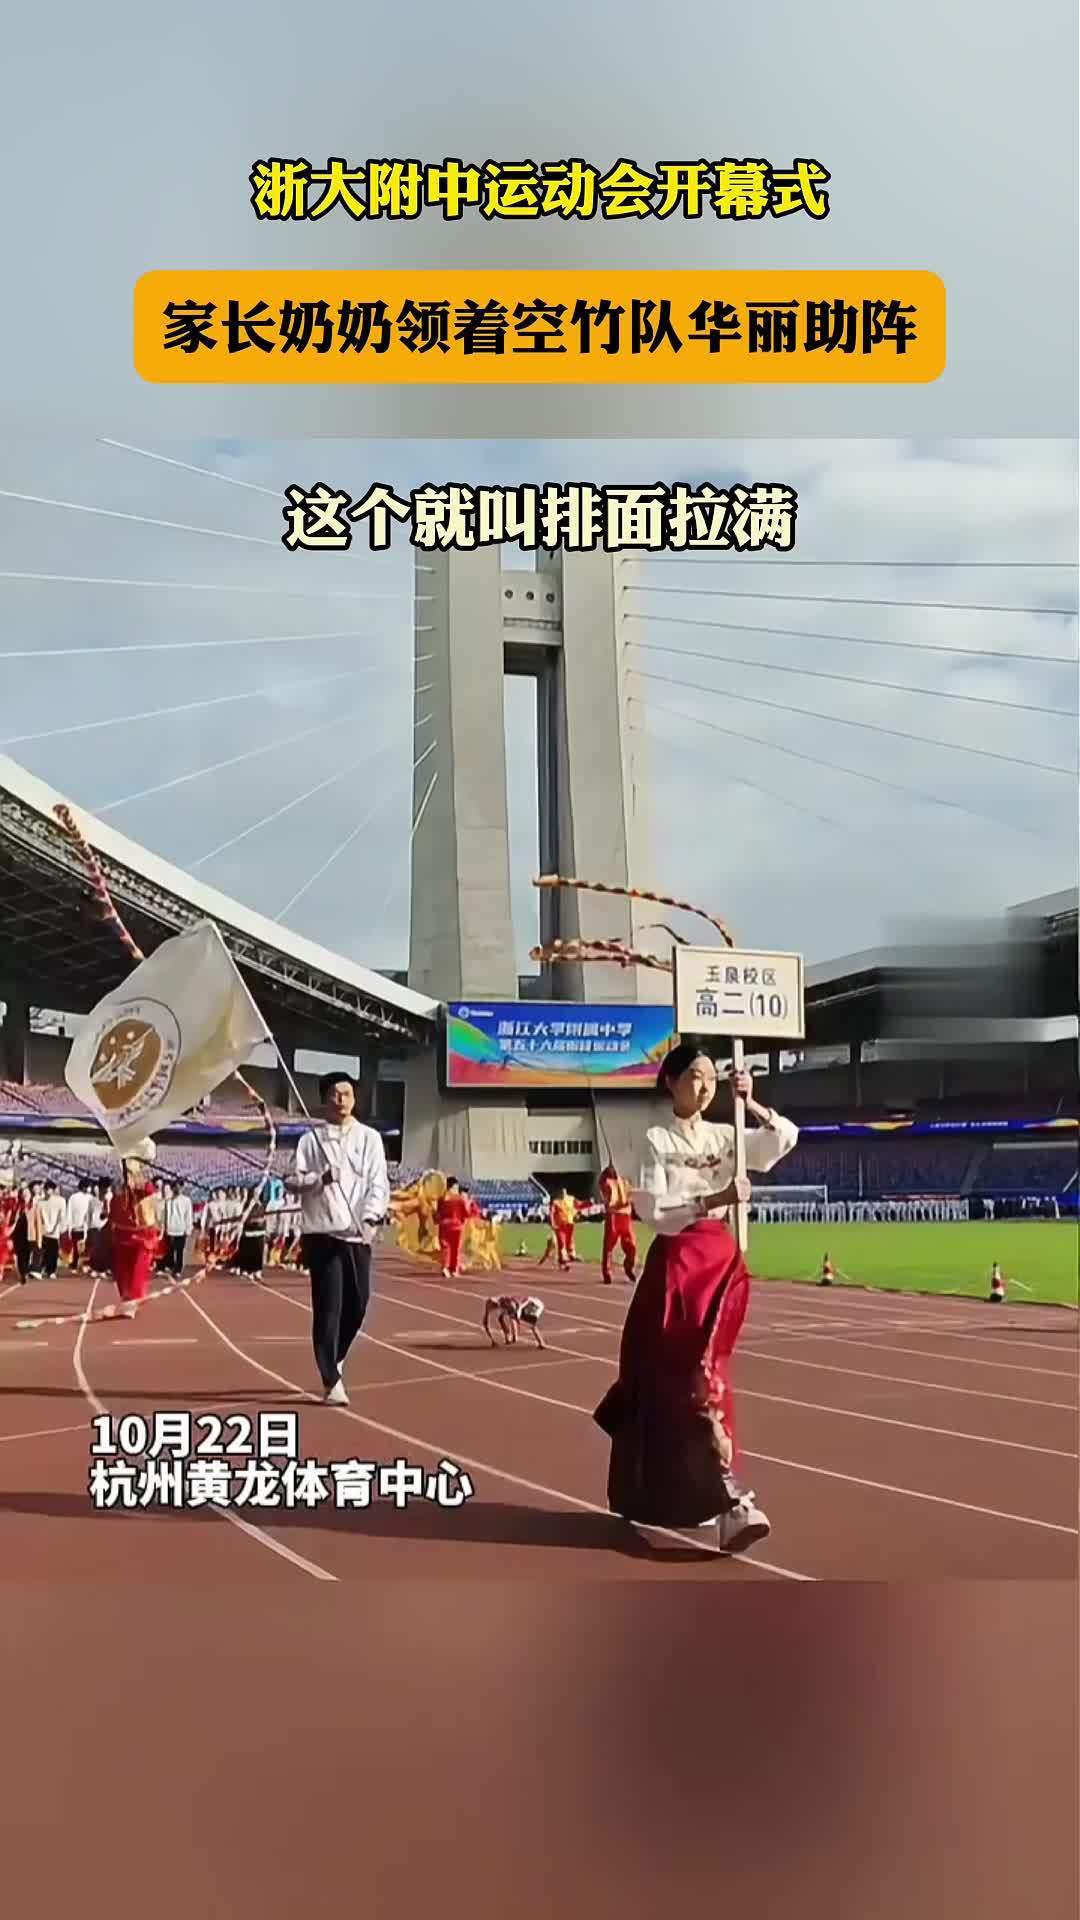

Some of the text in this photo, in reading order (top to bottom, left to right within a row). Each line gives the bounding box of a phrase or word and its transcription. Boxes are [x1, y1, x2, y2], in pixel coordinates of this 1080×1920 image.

[704, 965, 777, 986] 玉泉校区
[695, 986, 789, 1019] 高二(10)
